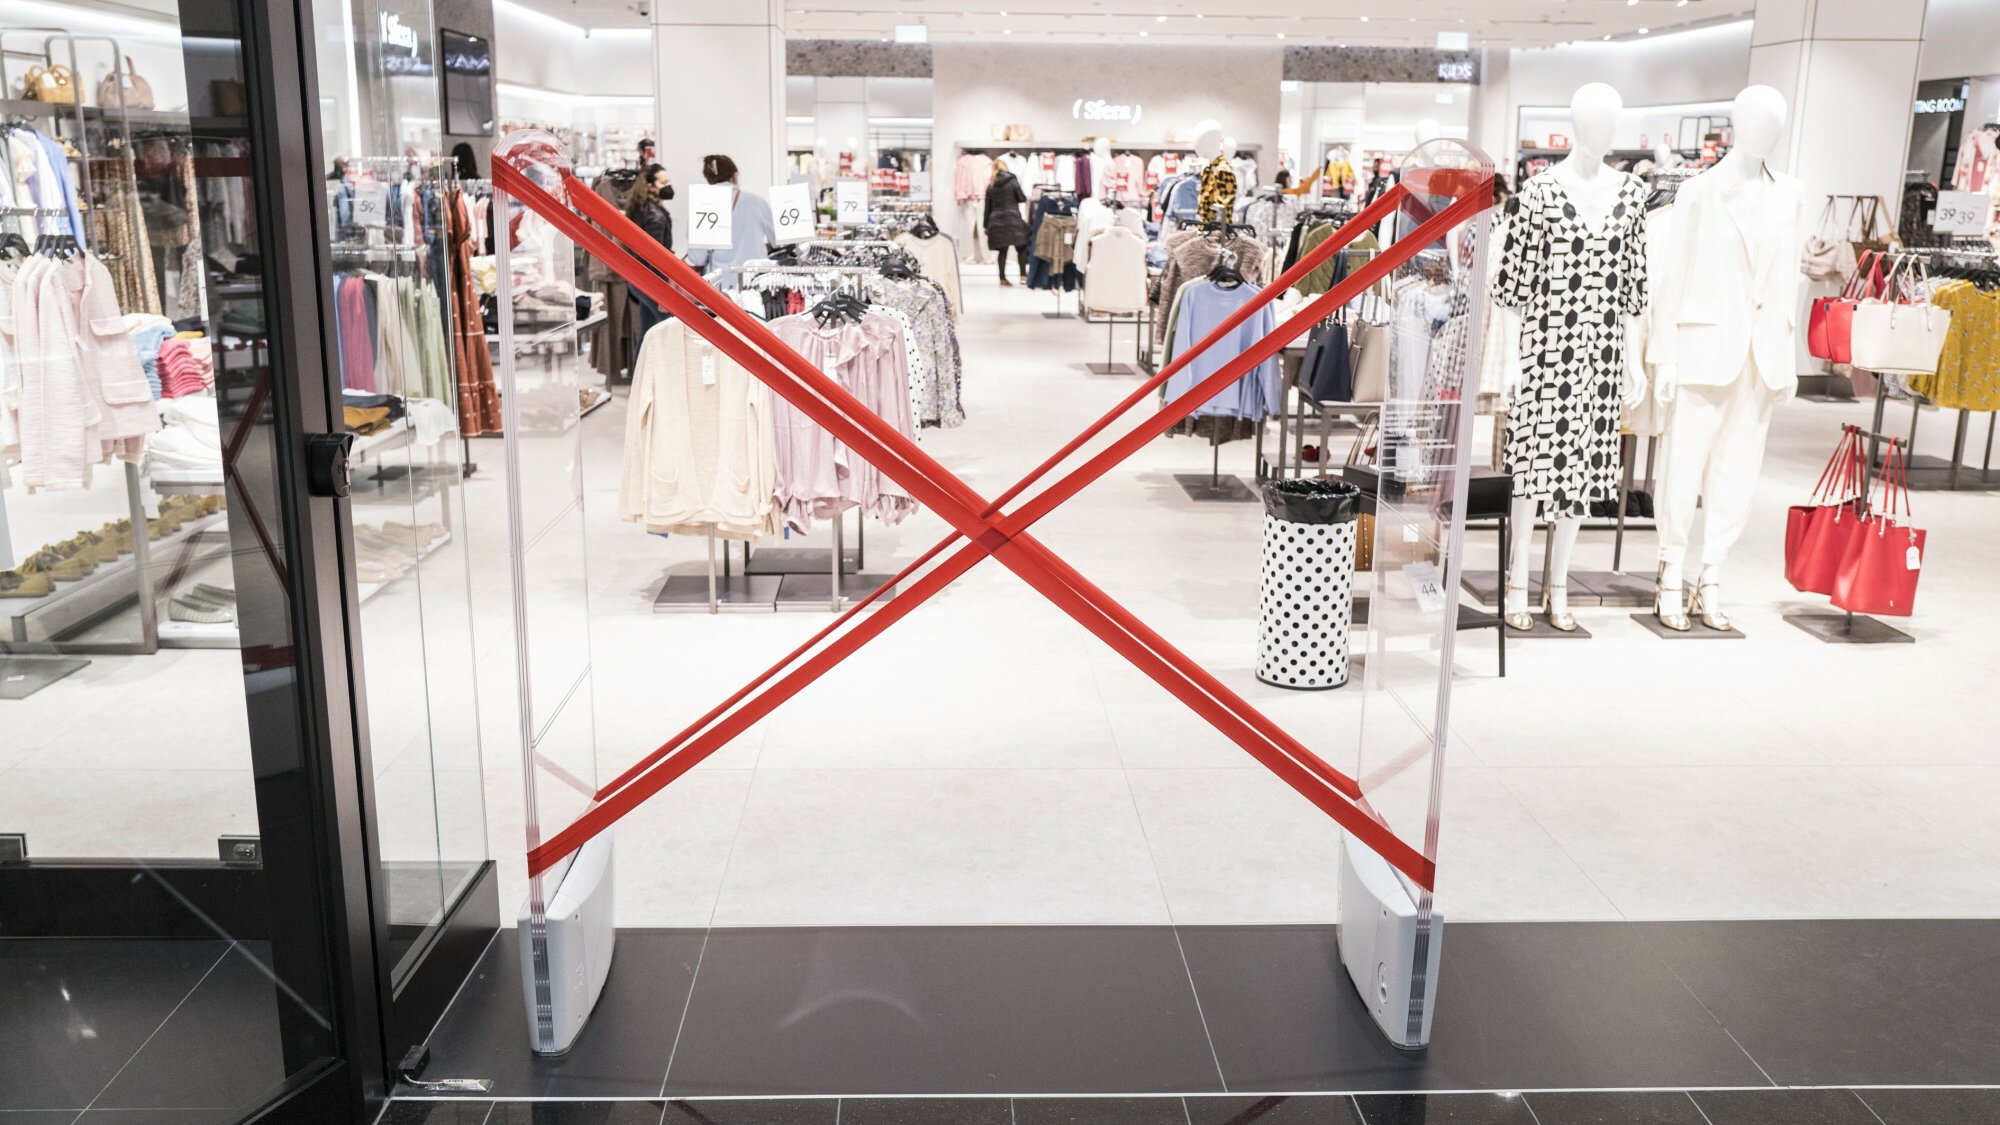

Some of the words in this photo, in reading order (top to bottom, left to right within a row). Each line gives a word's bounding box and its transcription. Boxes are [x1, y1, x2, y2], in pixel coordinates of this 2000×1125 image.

[1438, 63, 1473, 80] KIDS
[360, 199, 376, 213] 59
[842, 200, 858, 212] 79
[695, 211, 719, 230] 79
[779, 208, 800, 226] 69
[1940, 208, 1956, 221] 39
[1957, 210, 1975, 225] 39
[1420, 582, 1437, 597] 44
